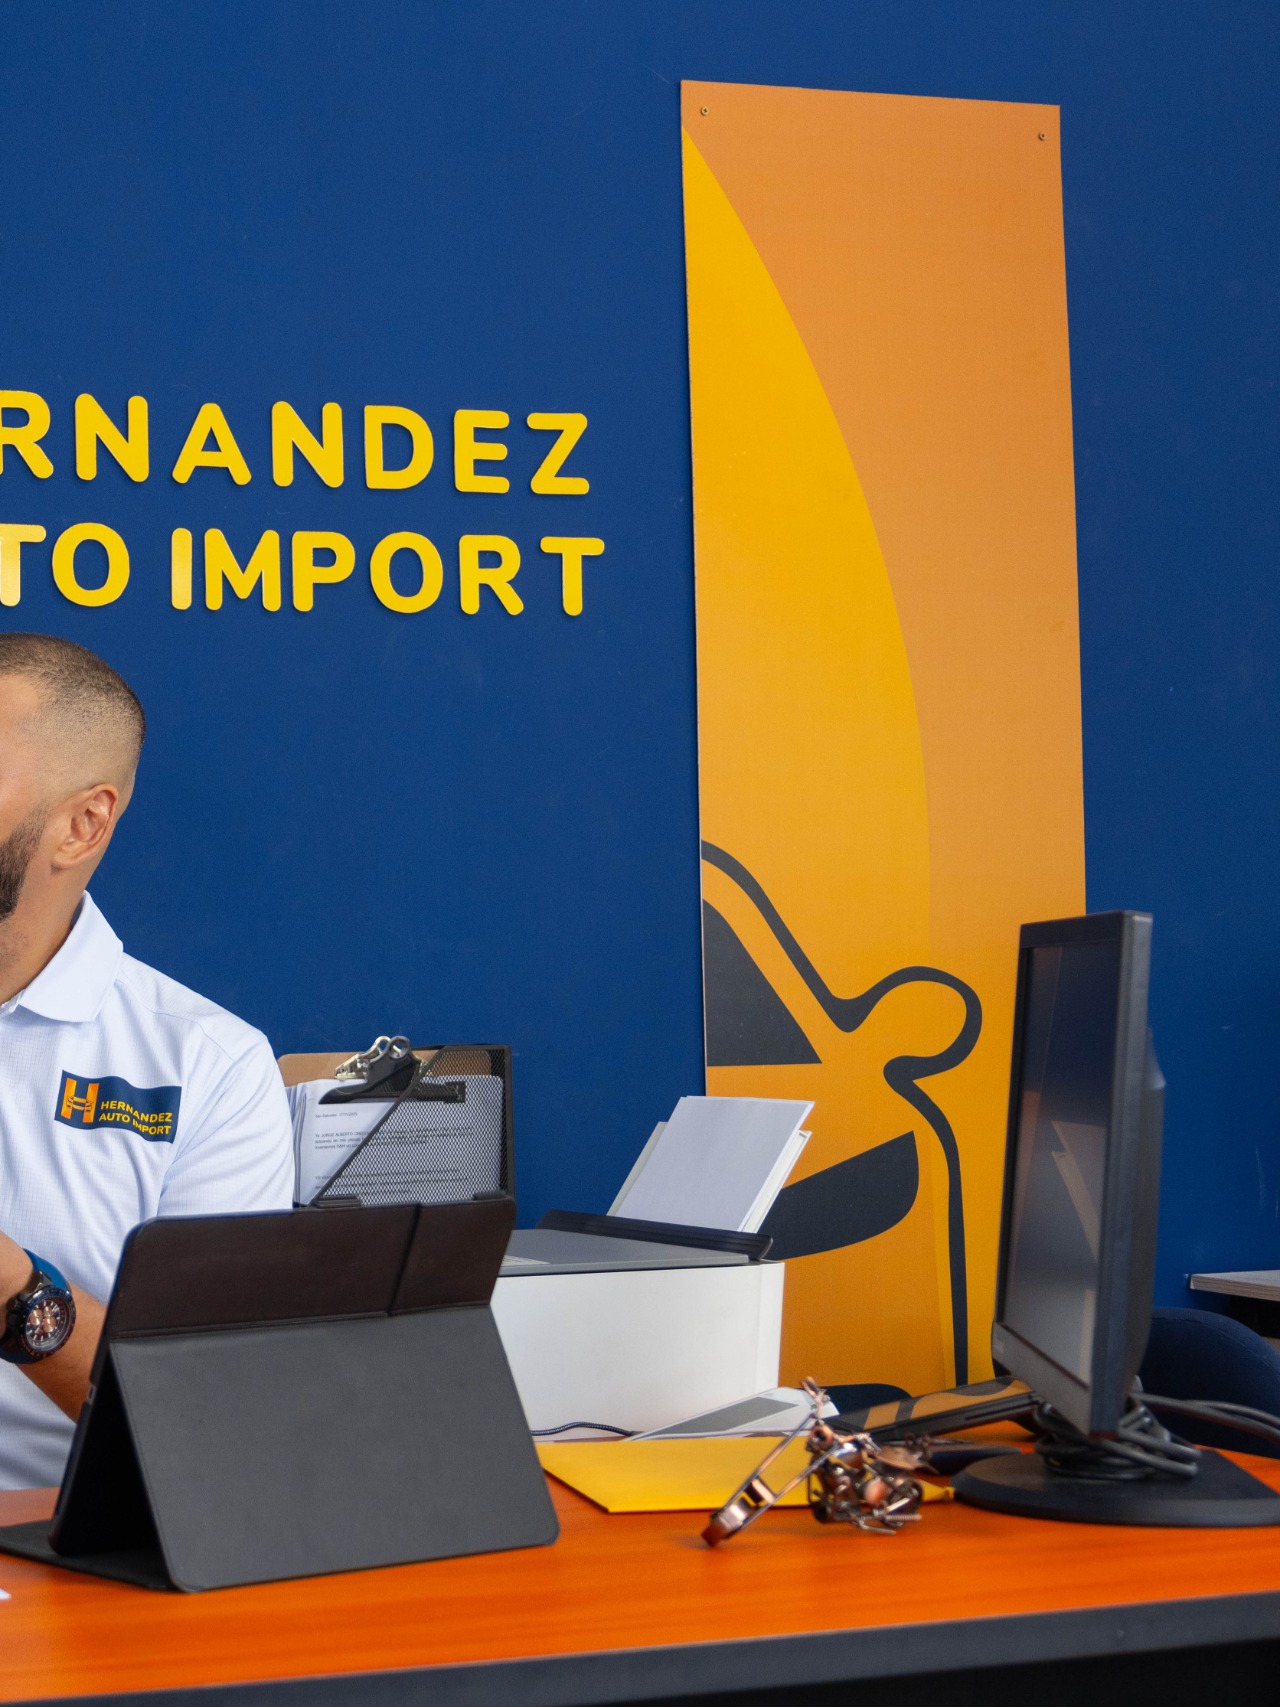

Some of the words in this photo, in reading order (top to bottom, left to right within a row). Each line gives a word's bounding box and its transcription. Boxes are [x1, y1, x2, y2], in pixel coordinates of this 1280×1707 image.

[170, 526, 606, 616] IMPORT
[61, 1077, 100, 1123] H
[100, 1100, 173, 1123] HERNANDEZ
[99, 1112, 131, 1123] AUTO
[132, 1119, 172, 1135] IMPORT
